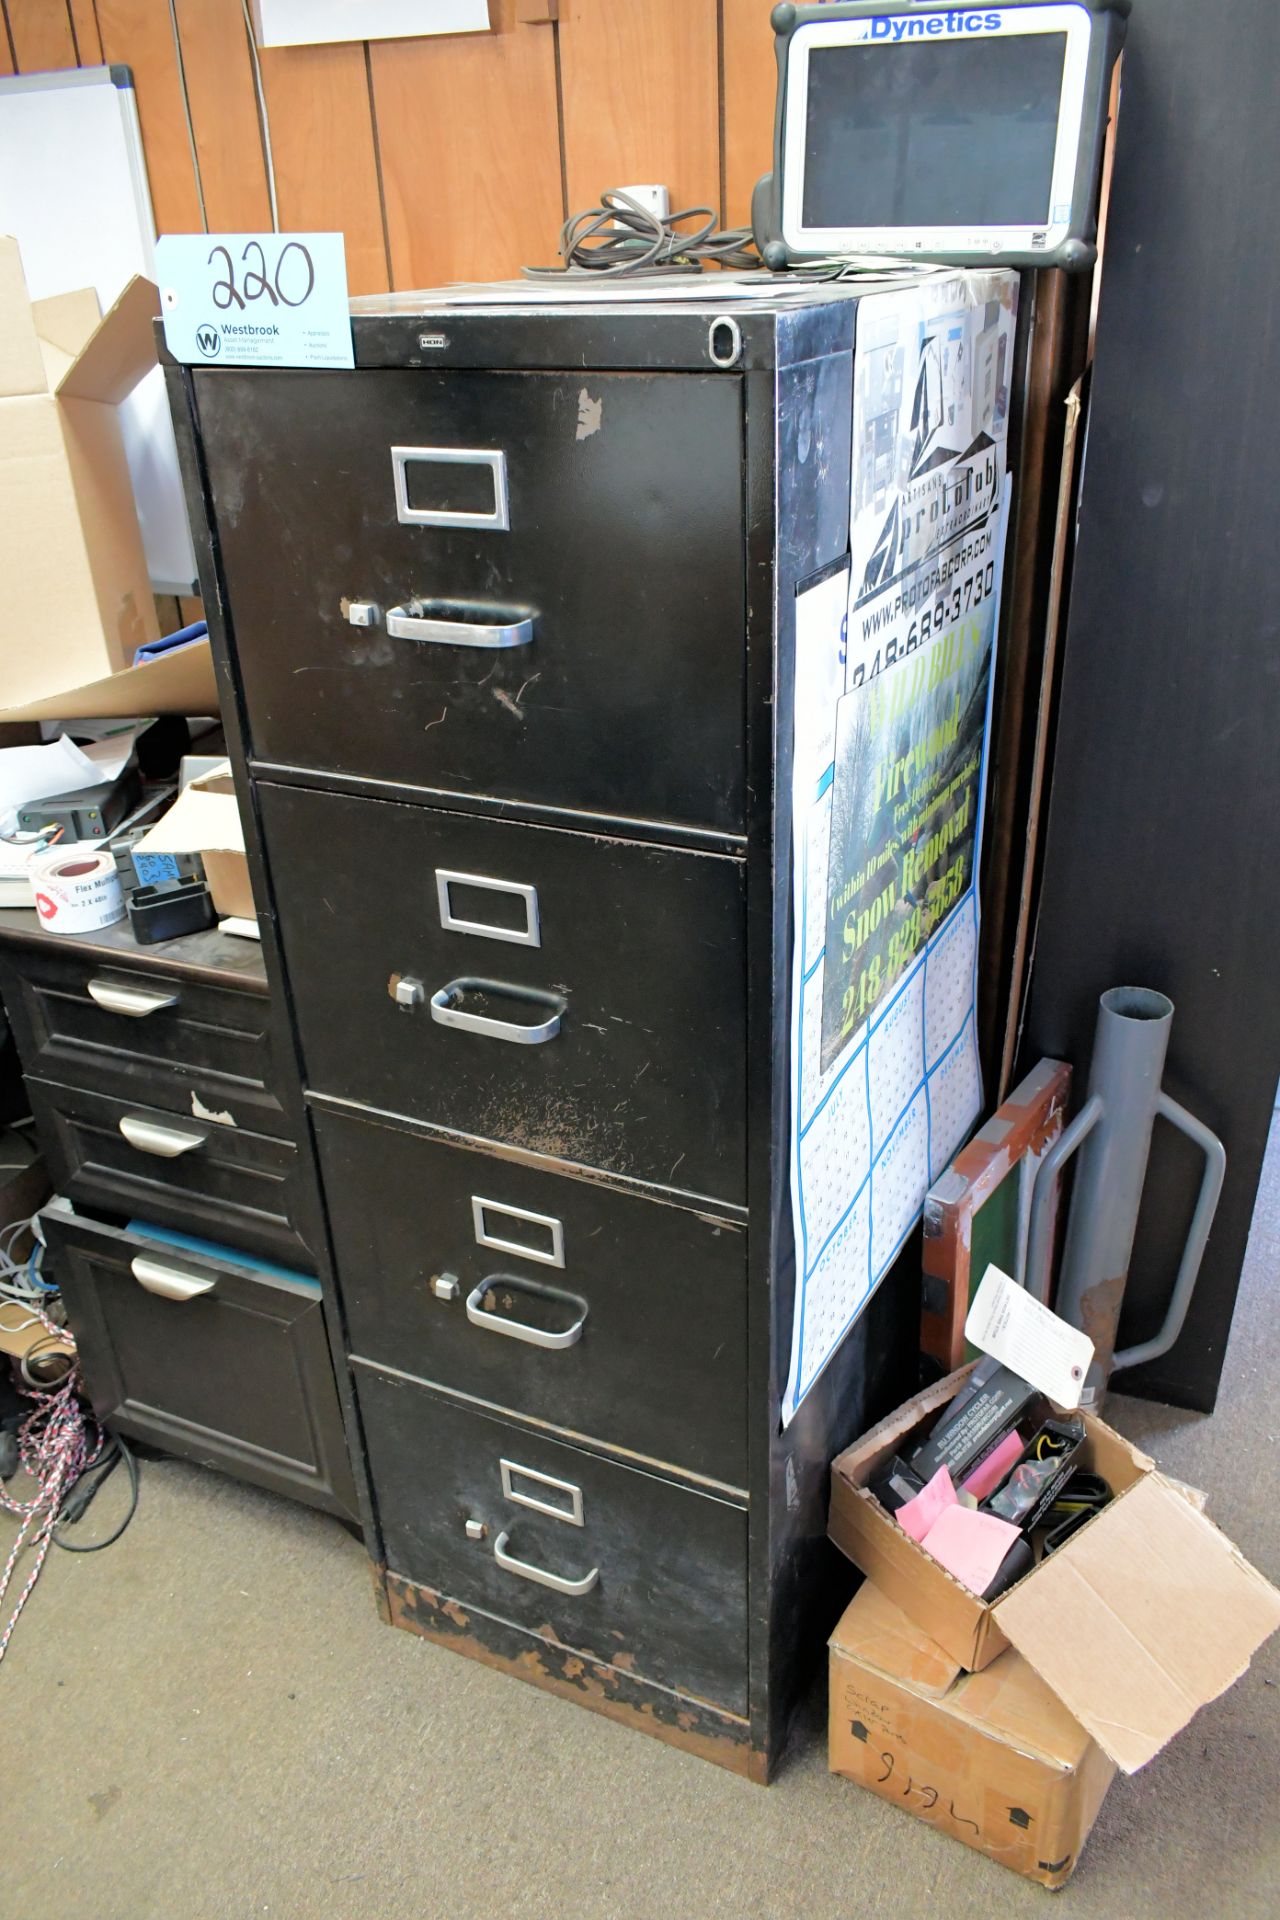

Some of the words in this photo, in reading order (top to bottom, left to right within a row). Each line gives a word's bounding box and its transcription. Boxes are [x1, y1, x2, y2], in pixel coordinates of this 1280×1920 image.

[871, 12, 1002, 41] Dynetics
[208, 241, 314, 310] 220
[221, 324, 280, 336] Westbrook
[899, 457, 993, 555] protofab
[901, 475, 942, 506] ARTISANS
[862, 531, 992, 642] WWW.PROTOFABCORP.COM
[874, 693, 960, 815] Firewood
[75, 884, 92, 894] Flex
[842, 881, 897, 964] Snow
[902, 785, 971, 898] Removal
[867, 856, 876, 881] 10
[884, 989, 912, 1034] AUGUST
[827, 1087, 845, 1124] JULY
[881, 1106, 918, 1171] NOVEMBER
[819, 1209, 859, 1273] OCTOBER
[967, 1393, 991, 1417] CYCLER
